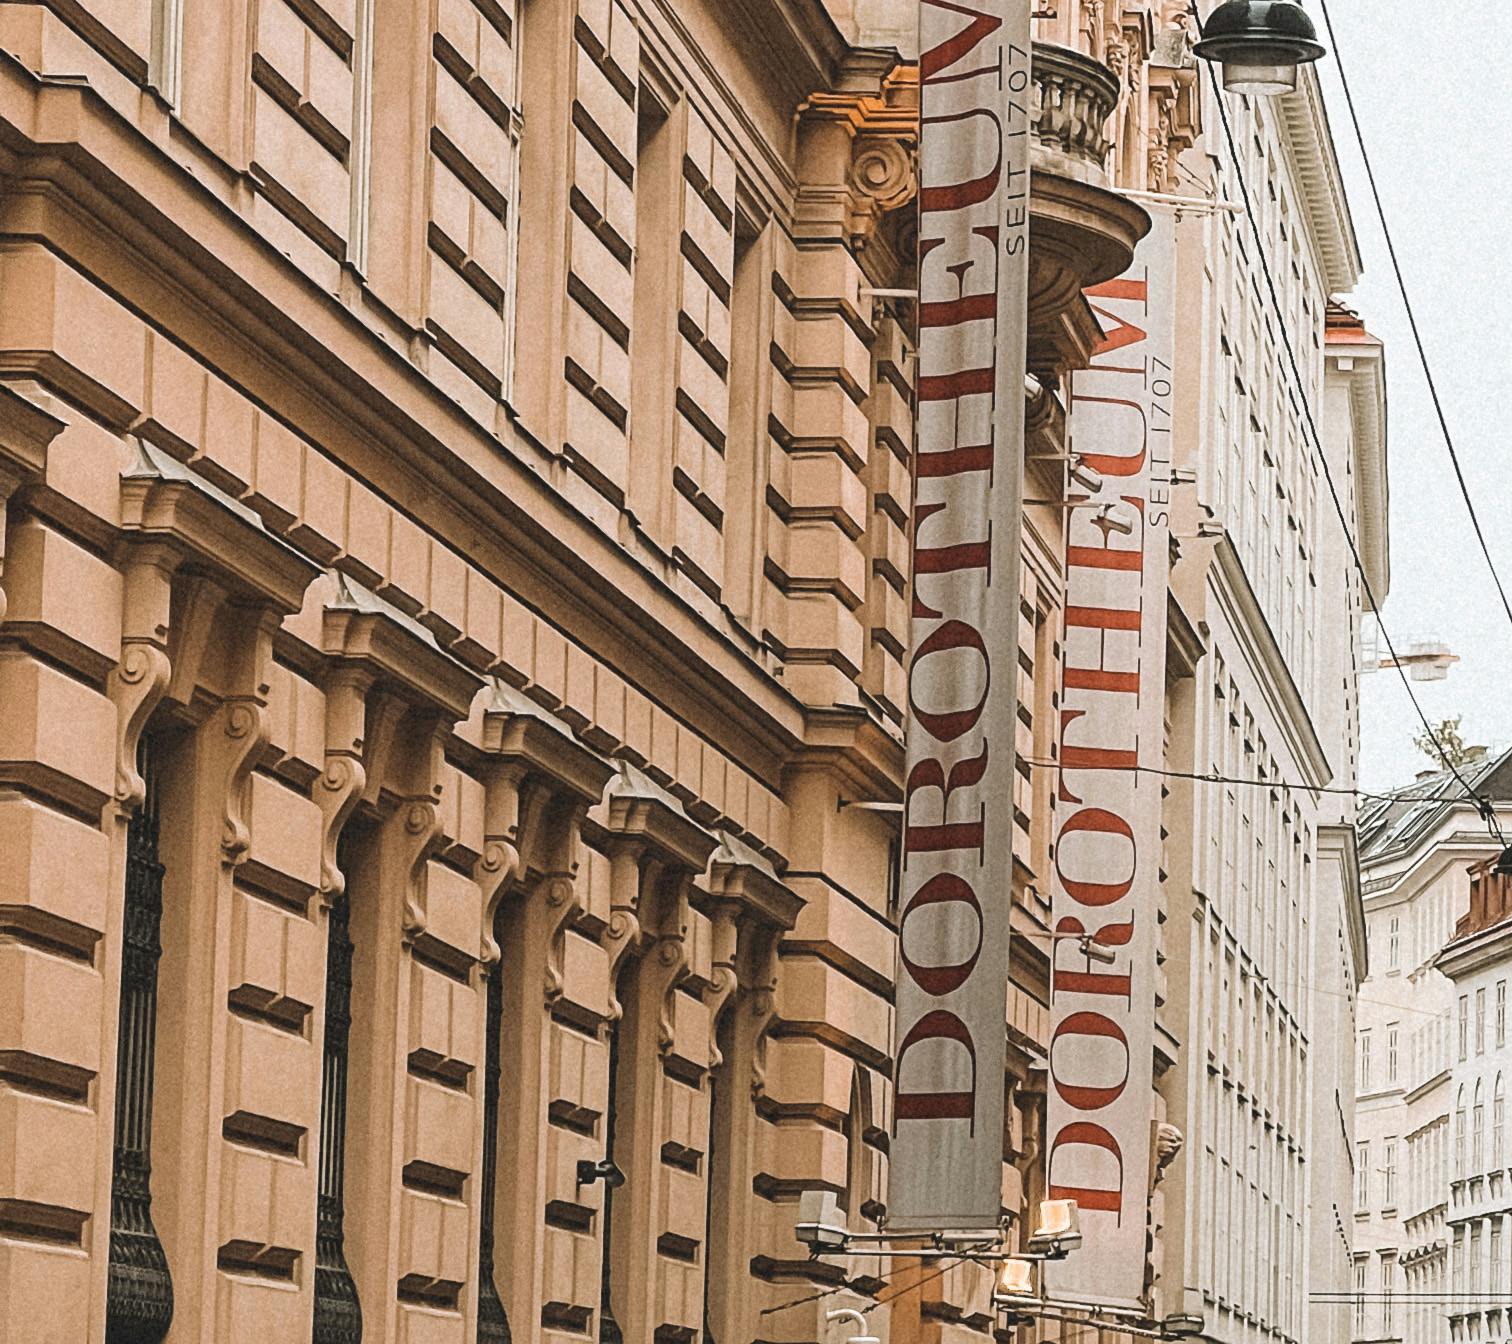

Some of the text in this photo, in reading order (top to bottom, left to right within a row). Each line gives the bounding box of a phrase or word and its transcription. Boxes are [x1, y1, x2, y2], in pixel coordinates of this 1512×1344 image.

[1006, 43, 1028, 256] SEIT 1707
[1149, 356, 1172, 527] SEIT 1707
